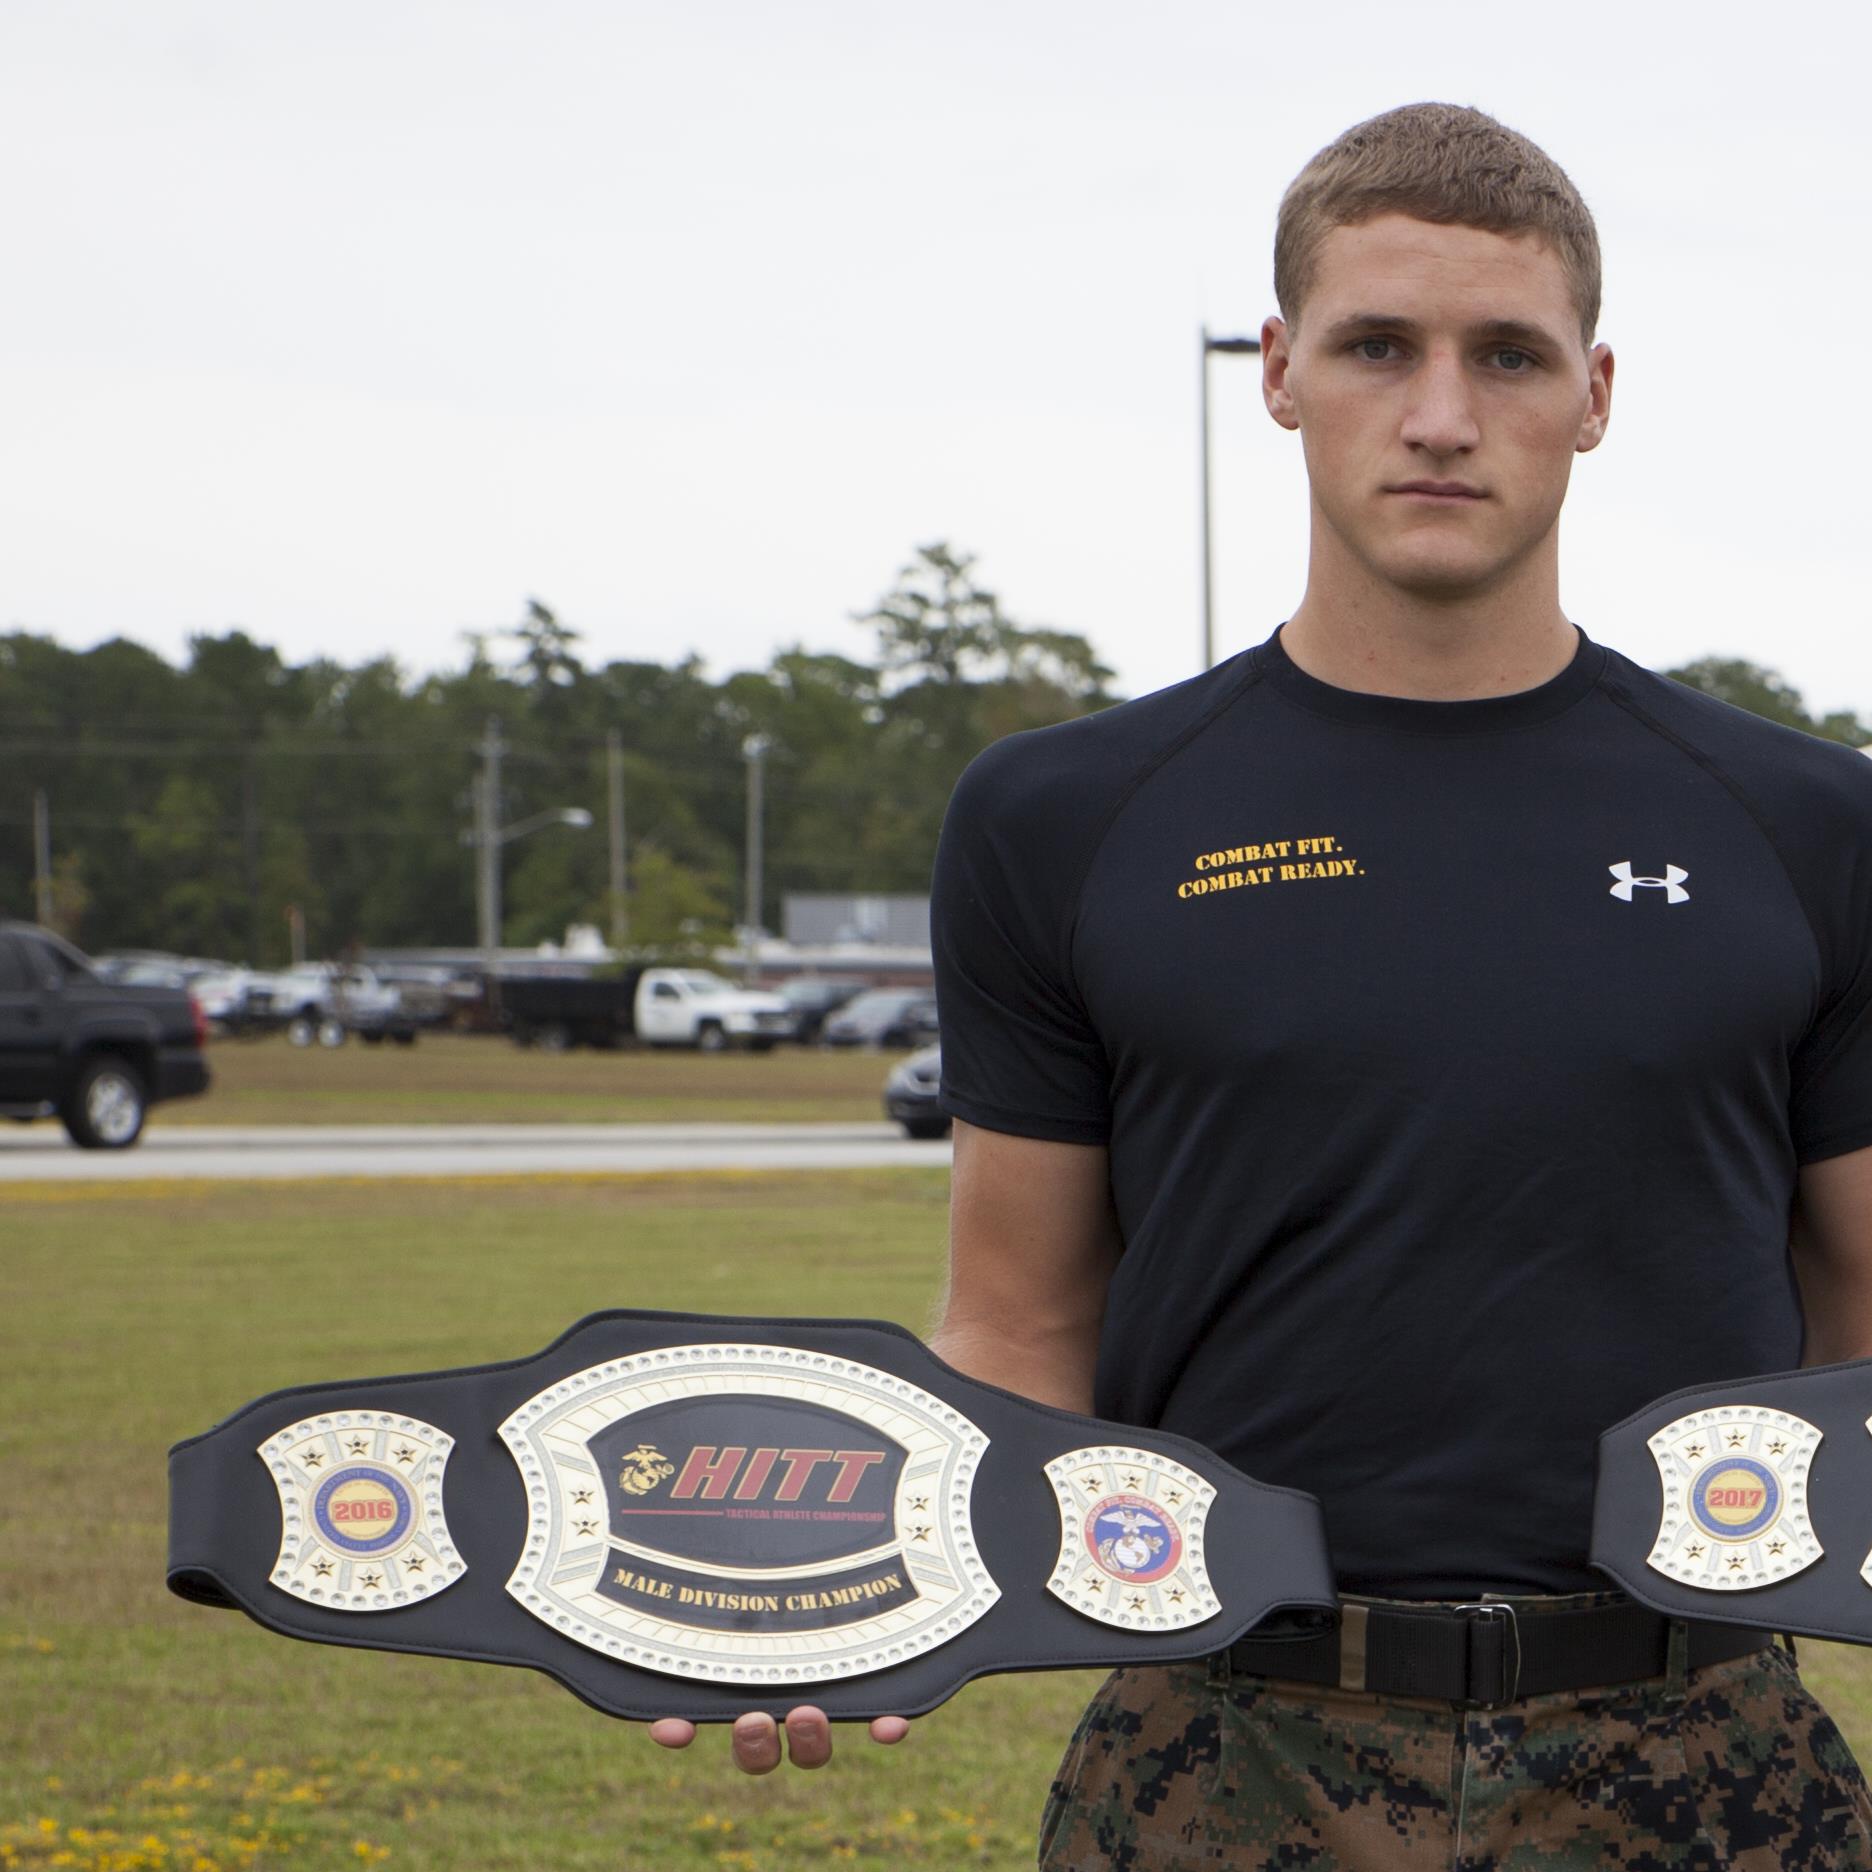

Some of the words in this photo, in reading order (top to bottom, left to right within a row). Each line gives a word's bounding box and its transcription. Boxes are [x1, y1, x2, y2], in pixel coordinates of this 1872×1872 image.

[1195, 841, 1291, 870] COMBAT
[1296, 836, 1343, 855] FIT.
[1177, 866, 1274, 899] COMBAT
[1280, 859, 1365, 881] READY.
[670, 1446, 886, 1503] HITT
[333, 1499, 394, 1522] 2016
[725, 1508, 771, 1521] TACTICAL
[772, 1509, 811, 1522] ATHLETE
[1708, 1489, 1763, 1508] 2017
[614, 1568, 672, 1599] MALE
[678, 1586, 779, 1612] DIVISION
[785, 1573, 902, 1612] CHAMPION
